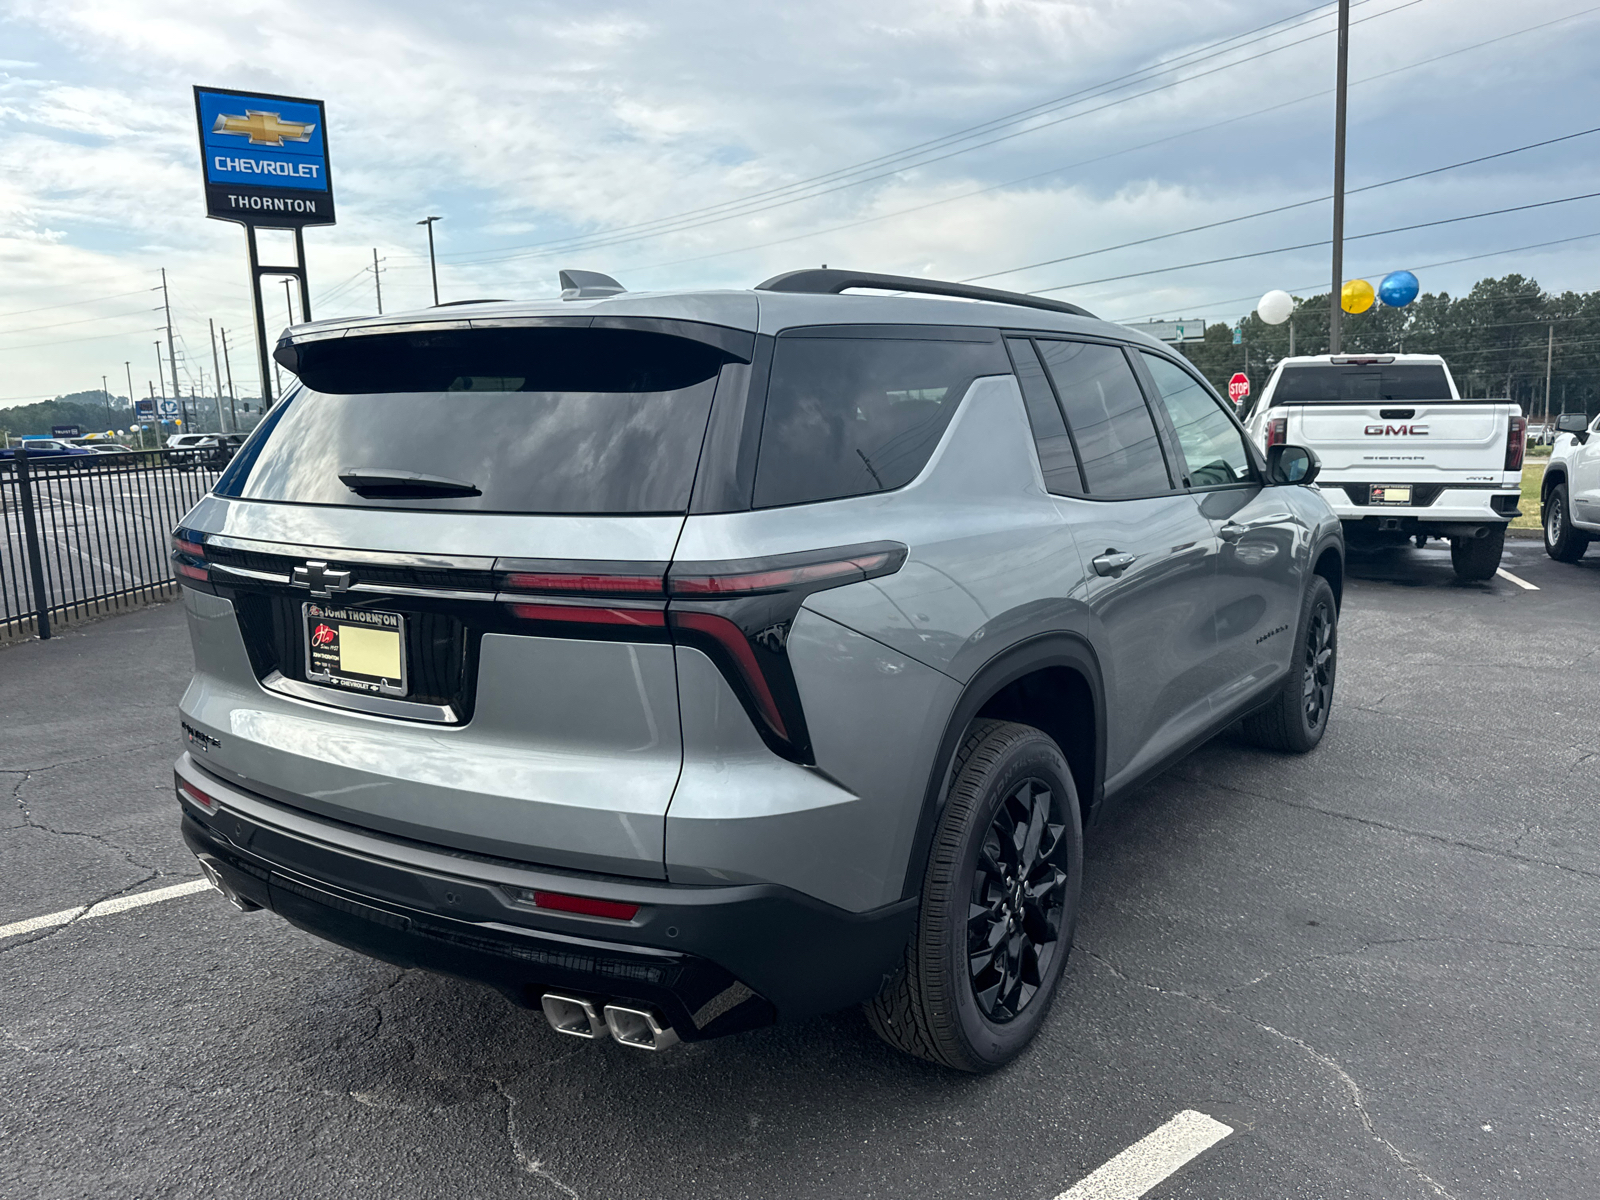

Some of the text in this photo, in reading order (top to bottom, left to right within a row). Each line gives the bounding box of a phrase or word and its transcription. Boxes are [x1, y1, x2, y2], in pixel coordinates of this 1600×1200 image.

[214, 156, 320, 178] CHEVROLET
[228, 195, 316, 213] THORNTON
[1230, 382, 1248, 395] STOP
[1364, 424, 1430, 436] GMC
[324, 607, 347, 619] JOHN
[348, 610, 397, 626] THORNTON
[340, 681, 369, 690] CHEVROLET
